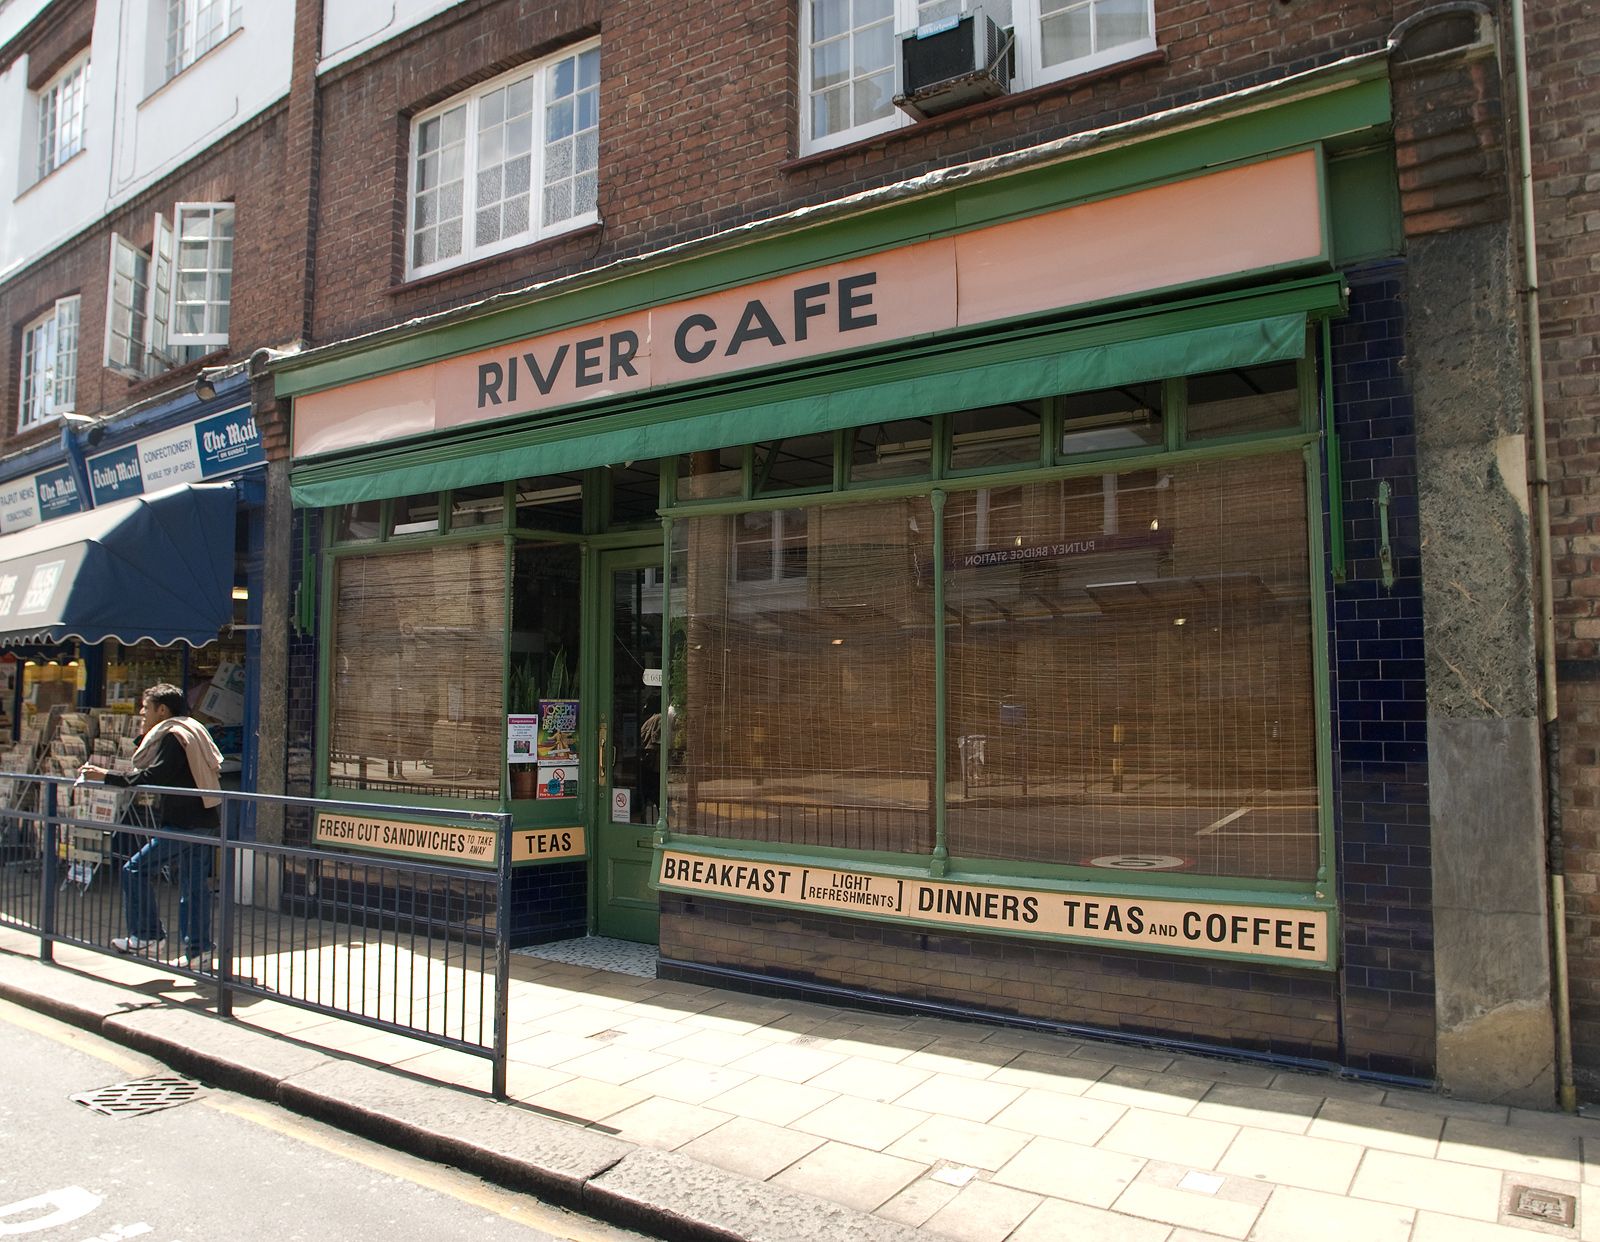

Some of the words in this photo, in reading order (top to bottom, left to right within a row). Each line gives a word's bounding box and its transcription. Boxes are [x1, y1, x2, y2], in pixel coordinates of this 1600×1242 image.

[476, 329, 640, 409] RIVER
[673, 271, 878, 365] CAFE
[203, 430, 227, 453] The
[225, 417, 258, 446] Mail
[143, 439, 193, 464] CONFECTIONERY
[40, 483, 56, 502] The
[54, 475, 78, 497] Mail
[93, 467, 119, 490] Daily
[115, 458, 141, 482] Mail
[319, 818, 354, 839] FRESH
[357, 823, 380, 843] CUT
[383, 826, 465, 853] SANDWICHES
[467, 834, 476, 845] TO
[477, 835, 493, 846] TAKE
[525, 832, 572, 854] TEAS
[469, 845, 487, 856] AWAY
[663, 857, 791, 894] BREAKFAST
[832, 873, 872, 892] LIGHT
[808, 886, 894, 909] REFRESHMENTS
[918, 887, 1039, 924] DINNERS
[1063, 900, 1145, 936] TEAS
[1149, 923, 1178, 938] AND
[1182, 911, 1316, 952] COFFEE
